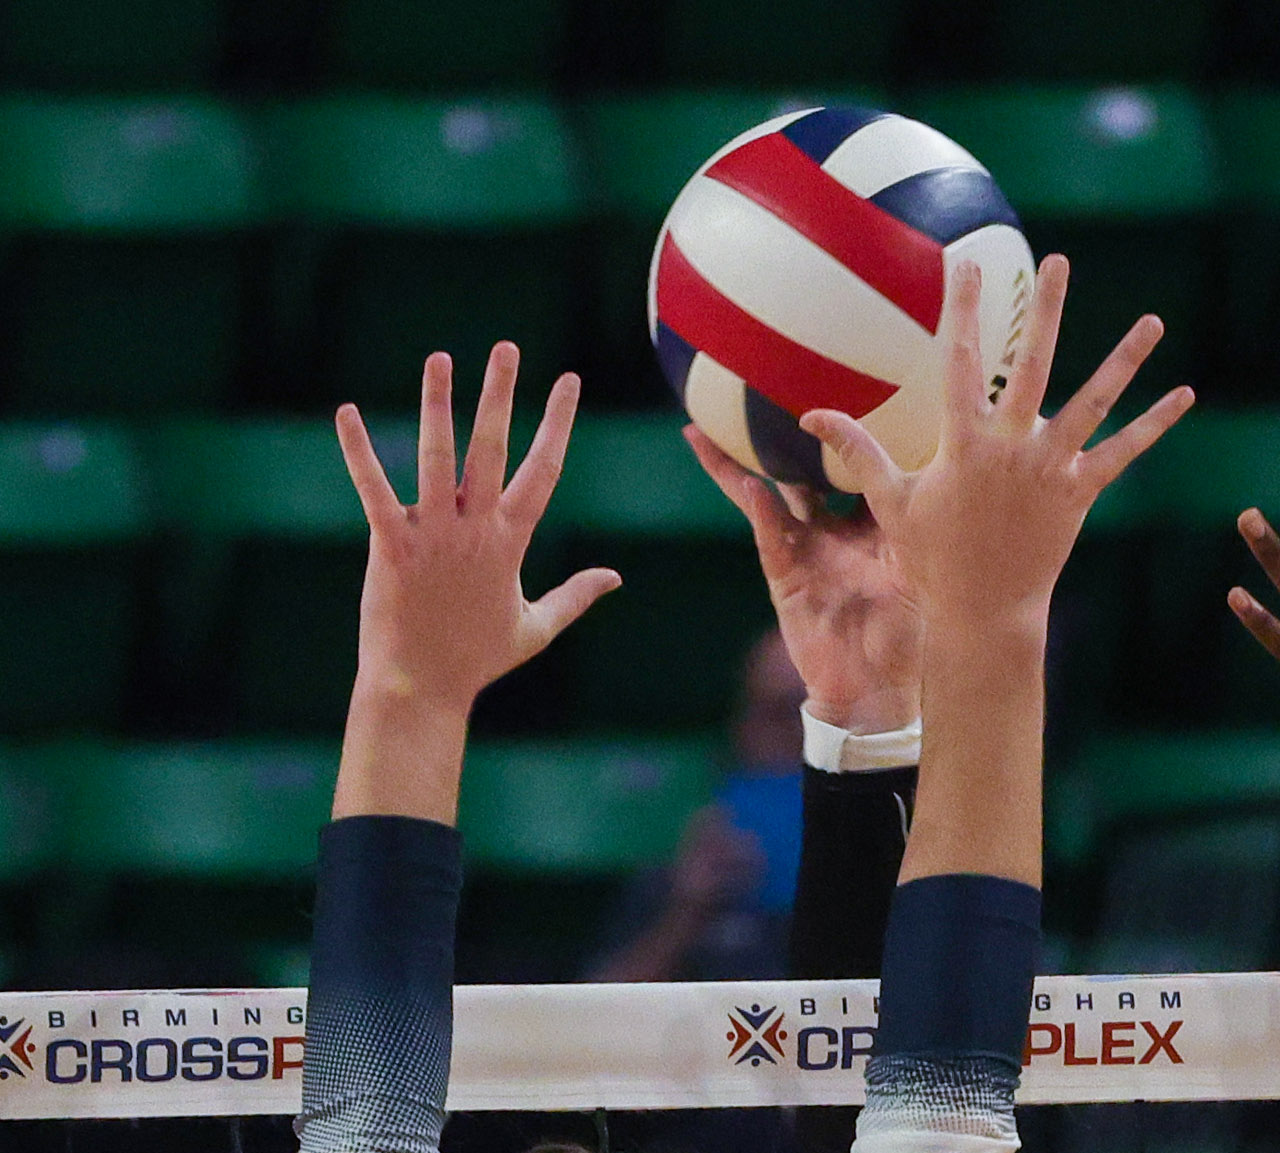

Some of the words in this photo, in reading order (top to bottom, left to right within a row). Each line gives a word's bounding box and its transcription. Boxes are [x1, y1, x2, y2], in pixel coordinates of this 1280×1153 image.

[48, 1006, 304, 1029] BIRMING
[800, 991, 1182, 1016] BIGHAM
[45, 1036, 306, 1083] CROSSP
[797, 1020, 1184, 1071] CRPLEX
